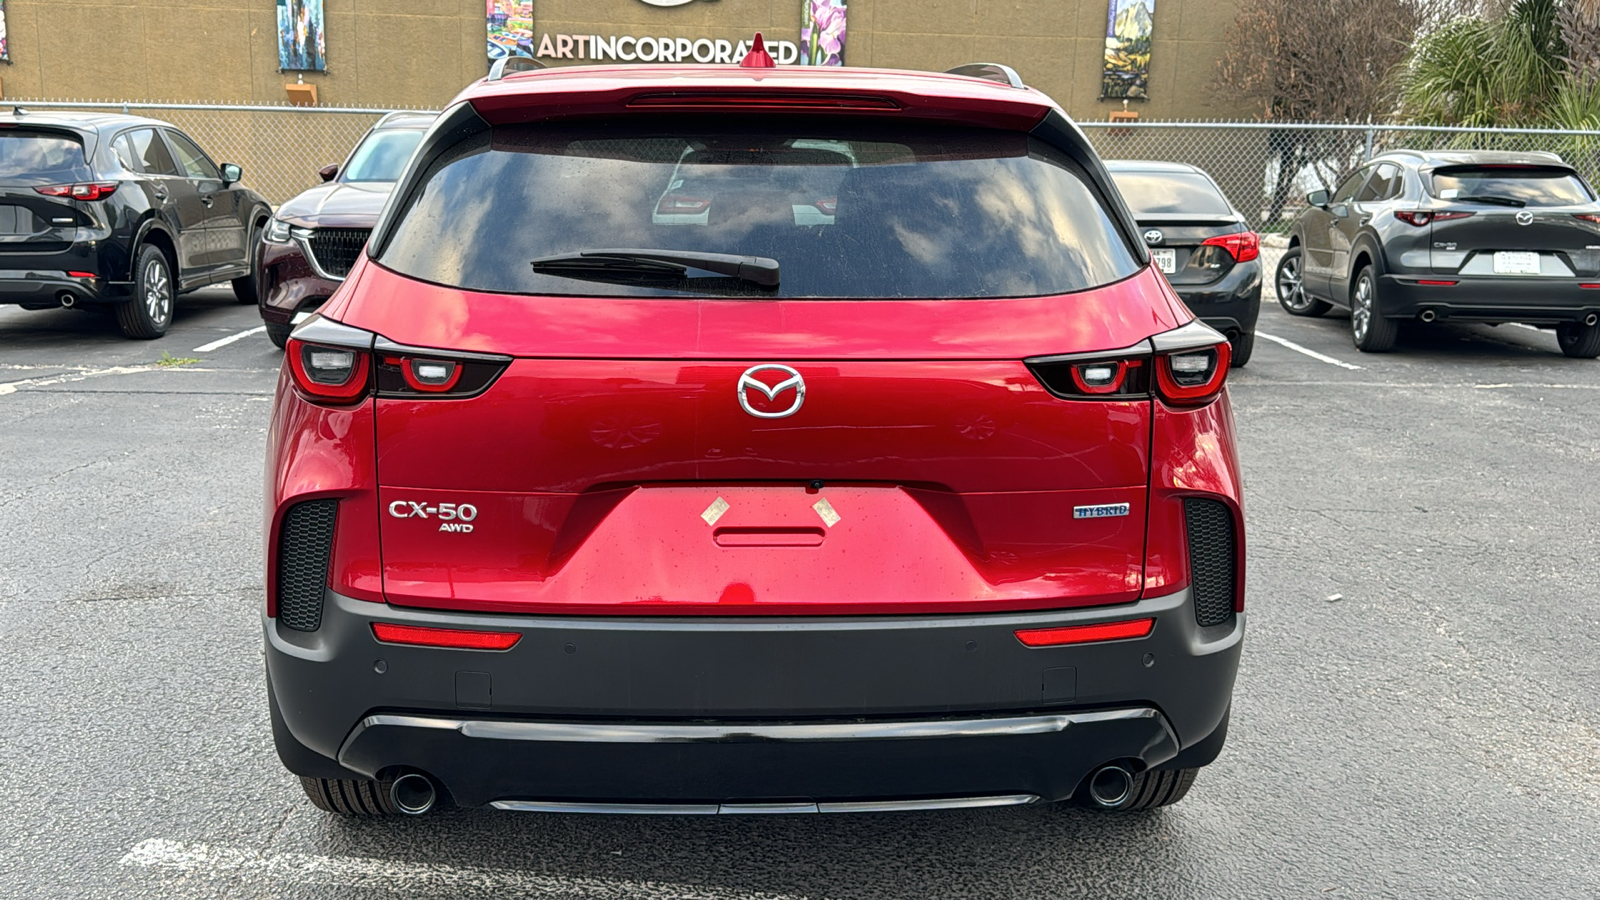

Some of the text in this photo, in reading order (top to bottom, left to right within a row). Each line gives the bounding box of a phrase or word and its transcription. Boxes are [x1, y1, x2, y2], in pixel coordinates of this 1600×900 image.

[389, 500, 478, 522] CX-50
[1077, 504, 1128, 517] HYBRID
[438, 523, 474, 533] AWD
